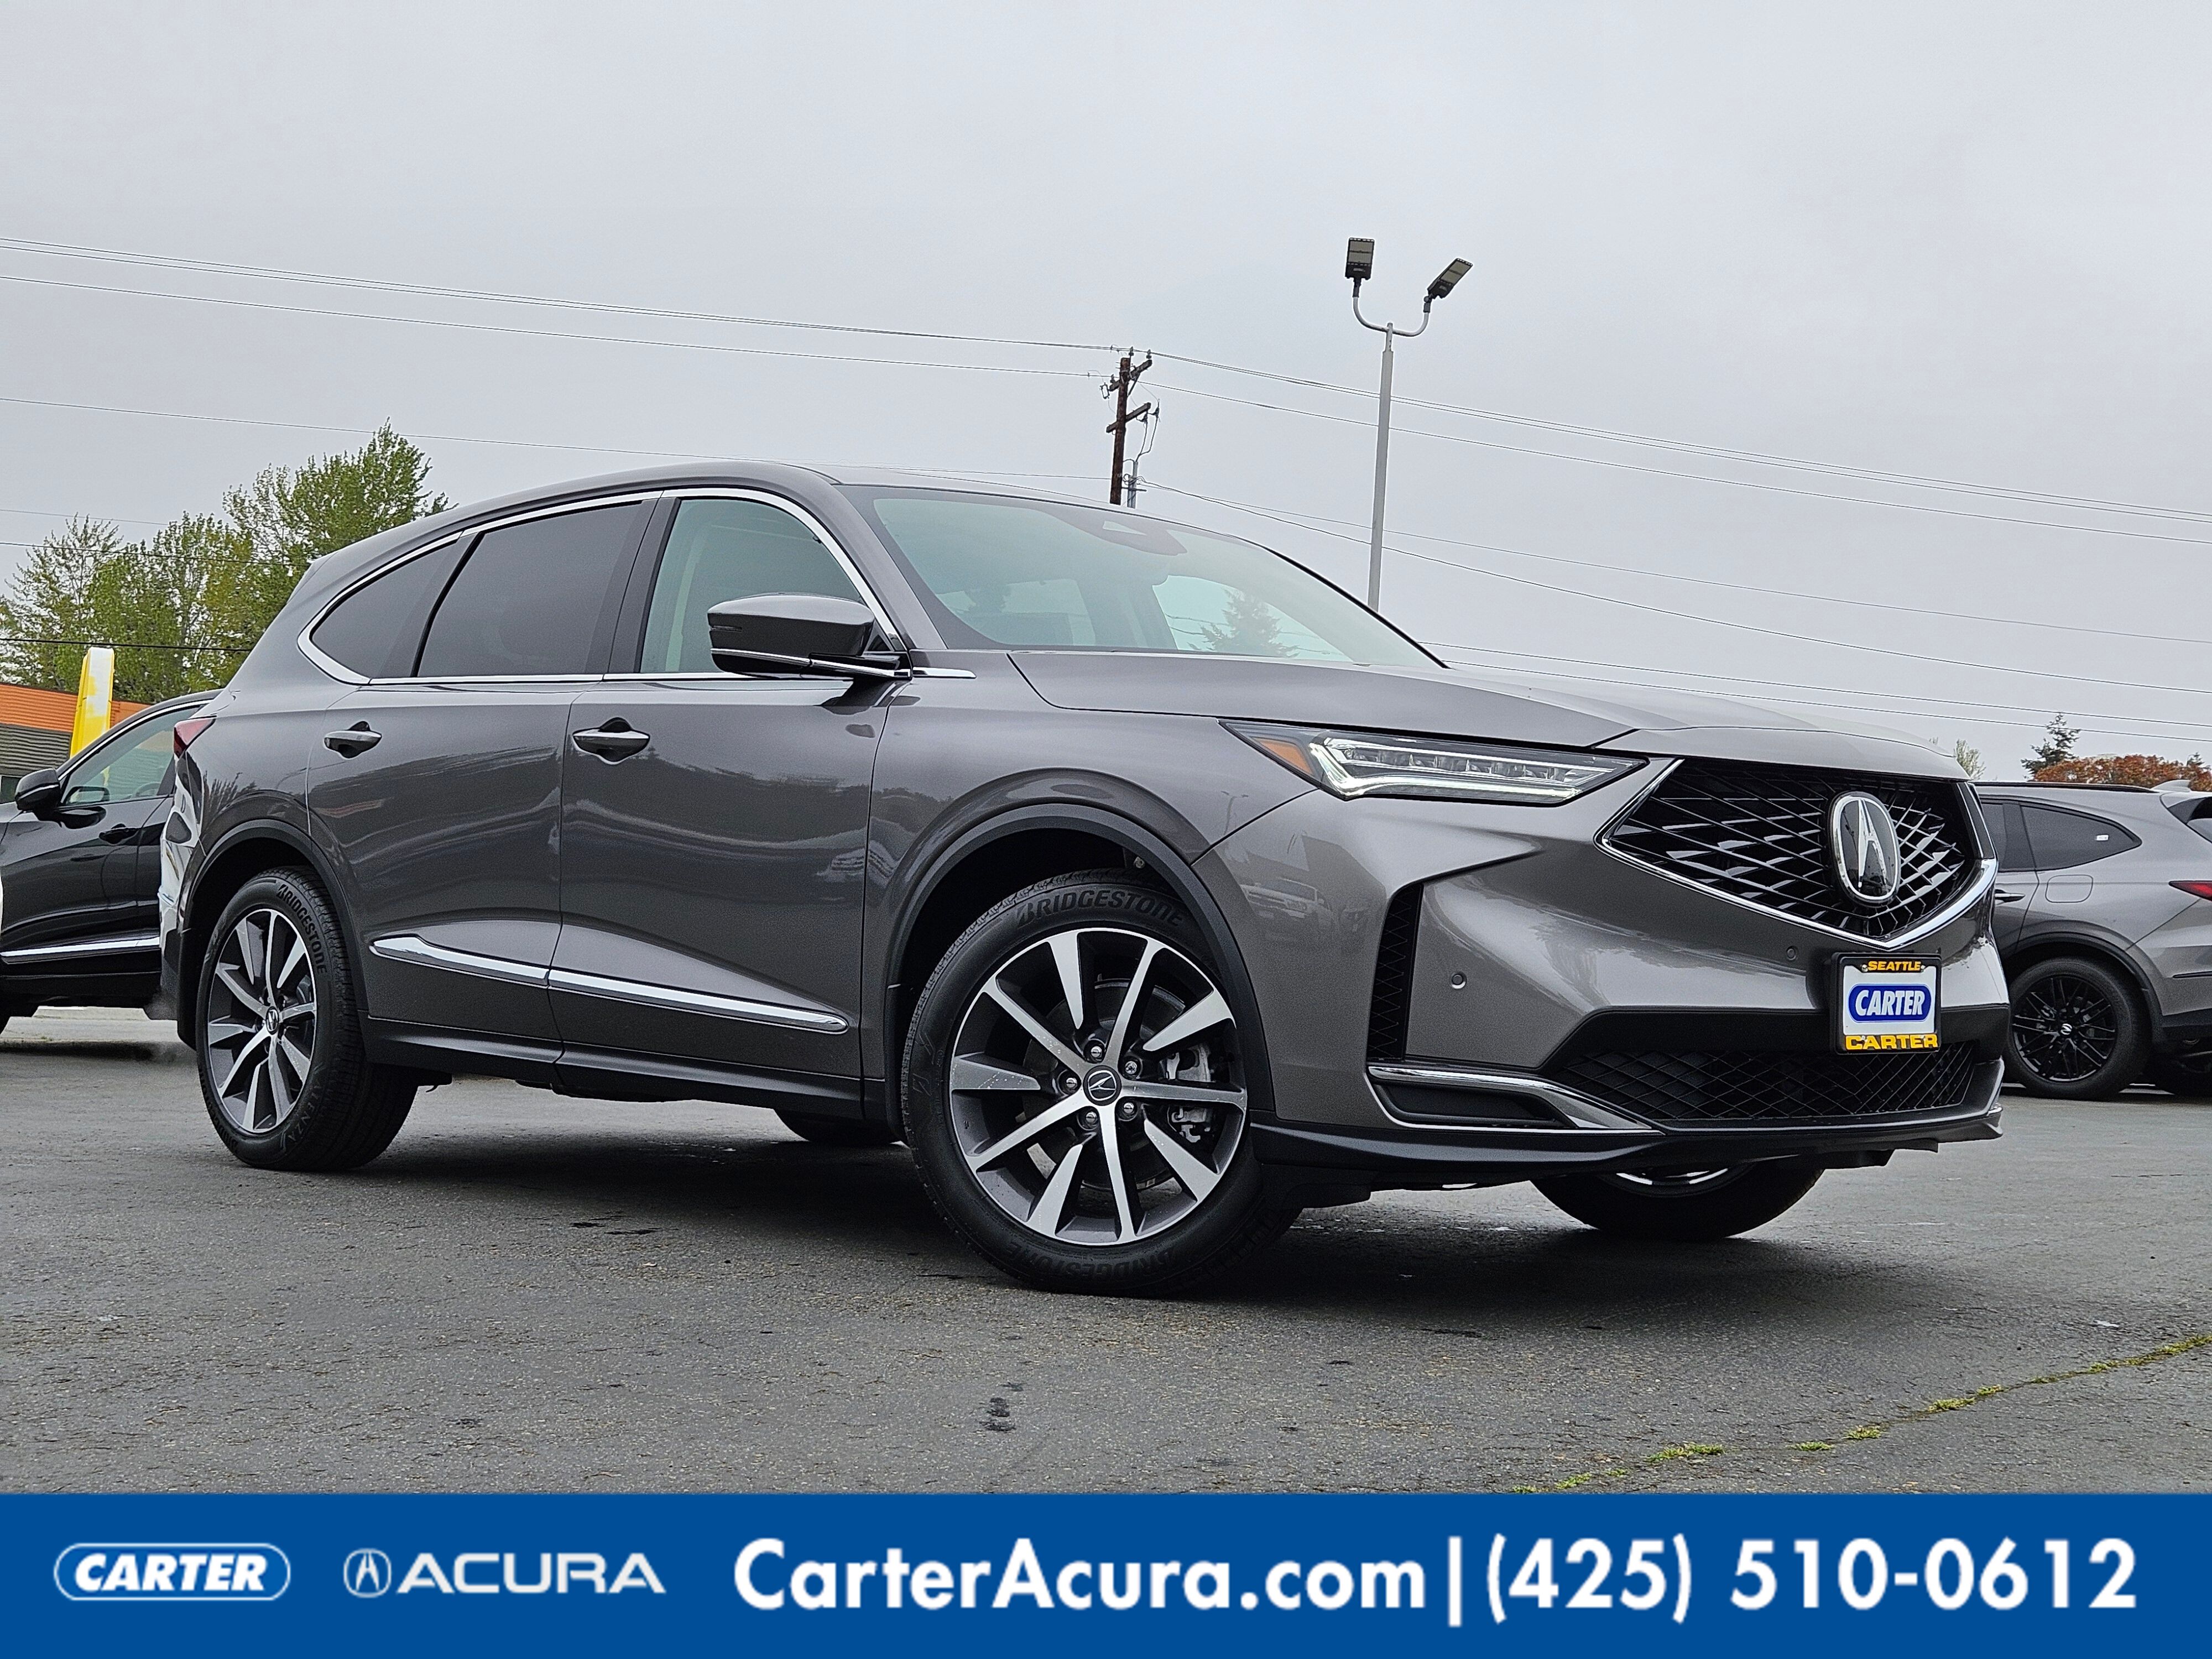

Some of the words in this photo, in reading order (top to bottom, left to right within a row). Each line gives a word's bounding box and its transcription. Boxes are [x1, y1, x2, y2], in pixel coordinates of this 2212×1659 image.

[1015, 889, 1183, 928] BRIDGESTONE
[276, 884, 327, 974] BRIDGESTONE
[1867, 961, 1922, 972] SEATTLE
[1855, 990, 1925, 1016] CARTER
[1845, 1034, 1938, 1050] CARTER
